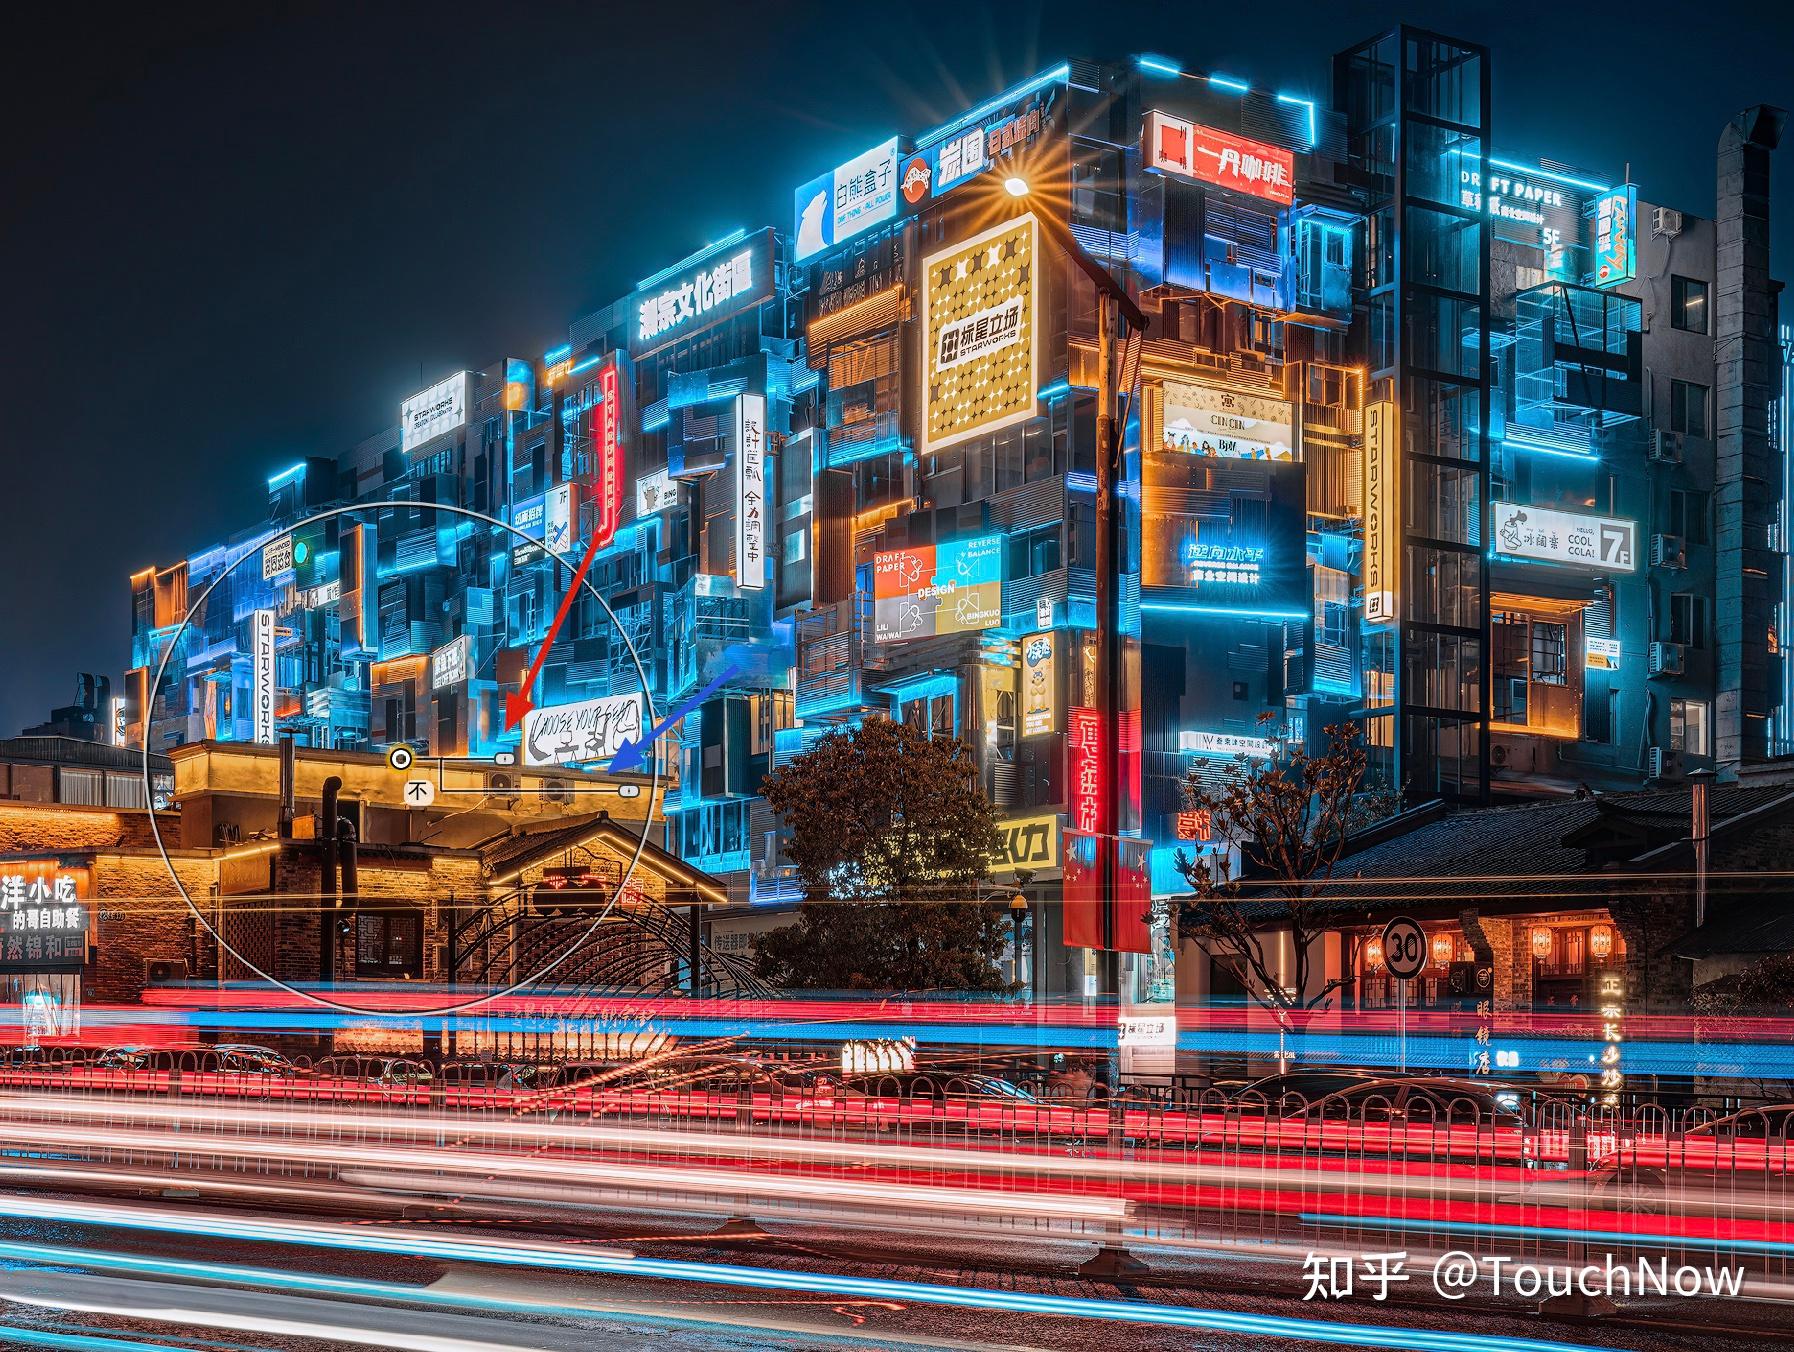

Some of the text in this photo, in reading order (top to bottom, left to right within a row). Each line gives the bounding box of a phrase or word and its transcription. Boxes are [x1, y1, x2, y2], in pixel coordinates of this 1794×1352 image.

[836, 158, 893, 210] 白熊盒子
[1461, 170, 1562, 207] DRFT PAPER
[1542, 226, 1560, 246] 5F
[960, 304, 1019, 348] 标星立场
[959, 329, 1017, 357] STARWORKS
[413, 396, 453, 422] STARWORKS
[559, 490, 568, 505] 7F
[663, 487, 677, 500] BING
[1370, 409, 1378, 588] STARWORKS
[1567, 534, 1593, 548] COOL
[1567, 546, 1595, 559] COLA!
[876, 551, 906, 564] DRAFT
[876, 561, 906, 574] PAPER
[917, 583, 955, 599] DESIGN
[534, 711, 575, 742] CHOOSE
[575, 705, 602, 731] YOUR
[1, 874, 77, 910] 洋小吃
[13, 908, 80, 930] 的哥自助餐
[0, 935, 62, 960] 然锦和
[1391, 932, 1418, 963] 30
